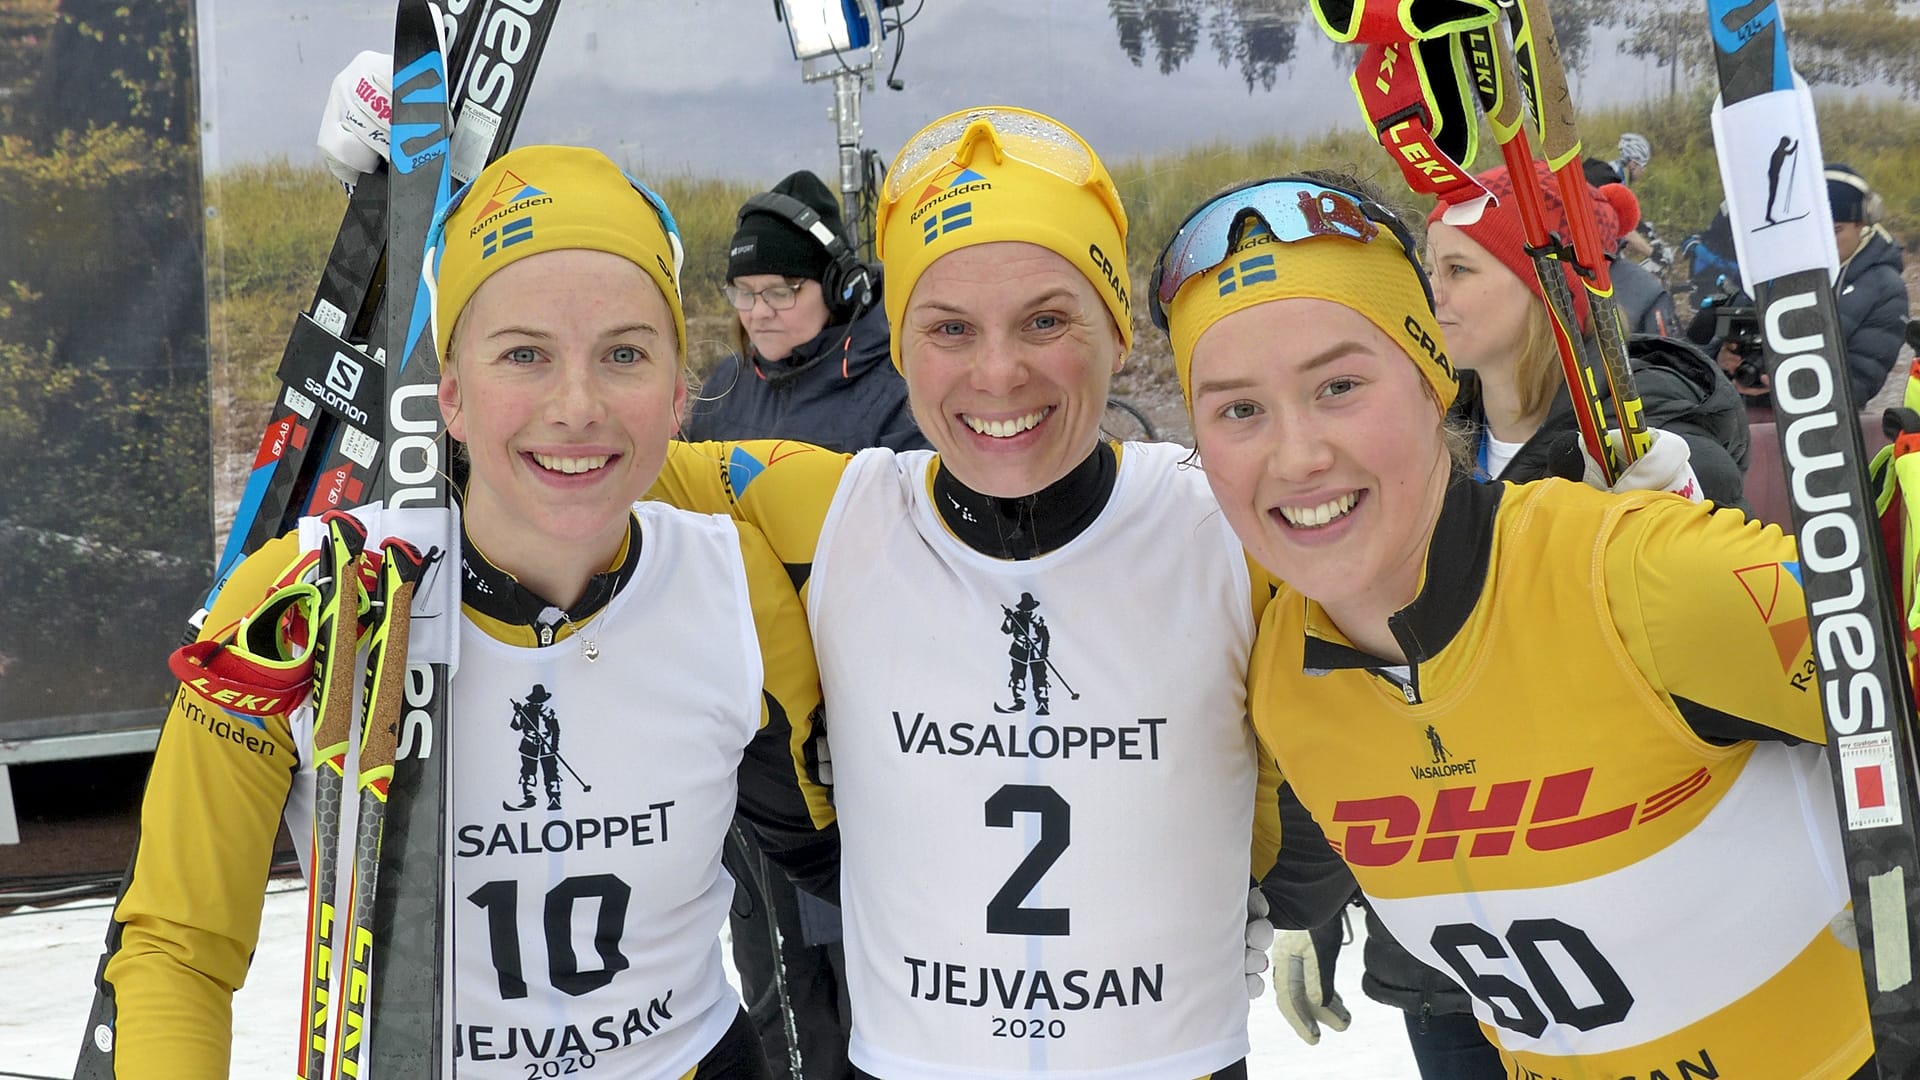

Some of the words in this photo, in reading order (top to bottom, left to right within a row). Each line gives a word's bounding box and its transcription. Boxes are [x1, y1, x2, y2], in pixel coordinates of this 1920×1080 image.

[1470, 33, 1495, 95] LEKI
[1388, 121, 1457, 184] LEKI
[469, 196, 554, 240] Ramudden
[909, 181, 993, 225] Ramudden
[1088, 244, 1131, 316] CRAFT
[1403, 315, 1459, 384] CRA
[303, 377, 369, 426] salomon
[1765, 290, 1886, 736] salomon
[189, 677, 281, 713] LEKI
[892, 711, 1168, 761] VASALOPPET
[1410, 758, 1477, 781] VASALOPPET
[455, 800, 676, 859] SALOPPET
[1331, 766, 1638, 867] DHL
[984, 783, 1071, 937] 2
[466, 872, 632, 1001] 10
[903, 955, 1165, 1011] TJEJVASAN
[1428, 917, 1636, 1040] 60
[455, 989, 674, 1062] JEJVASAN
[991, 1016, 1067, 1040] 2020
[523, 1053, 598, 1080] 2020
